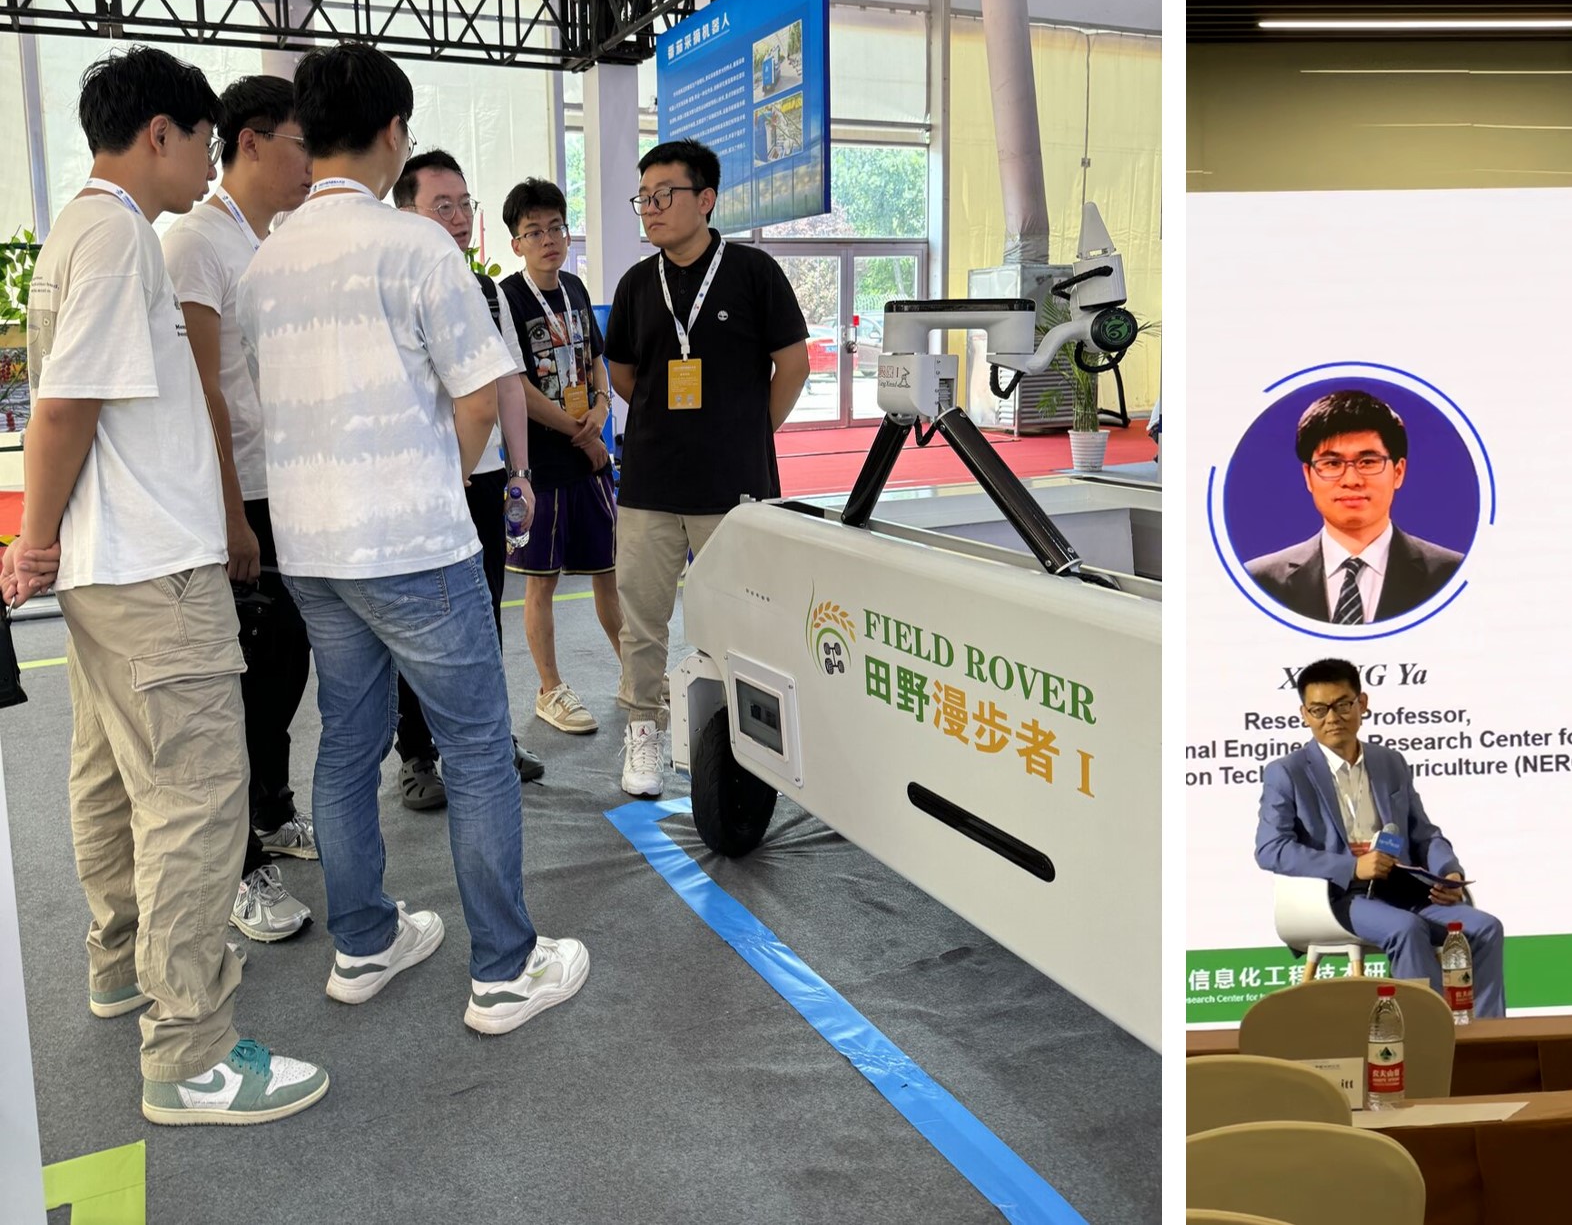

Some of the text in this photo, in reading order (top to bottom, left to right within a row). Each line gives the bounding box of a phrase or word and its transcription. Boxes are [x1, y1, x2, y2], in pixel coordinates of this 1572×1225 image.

[667, 11, 730, 61] 番茄采摘机器人
[863, 608, 1098, 726] FIELD ROVER
[1398, 662, 1428, 686] Ya
[864, 654, 1060, 785] 田野漫步者
[1244, 706, 1472, 731] Resea Professor,
[1186, 740, 1218, 760] nal
[1368, 732, 1472, 751] Research
[1480, 730, 1552, 748] Center
[1186, 768, 1213, 786] on
[1407, 757, 1509, 781] griculture
[1186, 995, 1215, 1004] search
[1217, 994, 1244, 1003] Center
